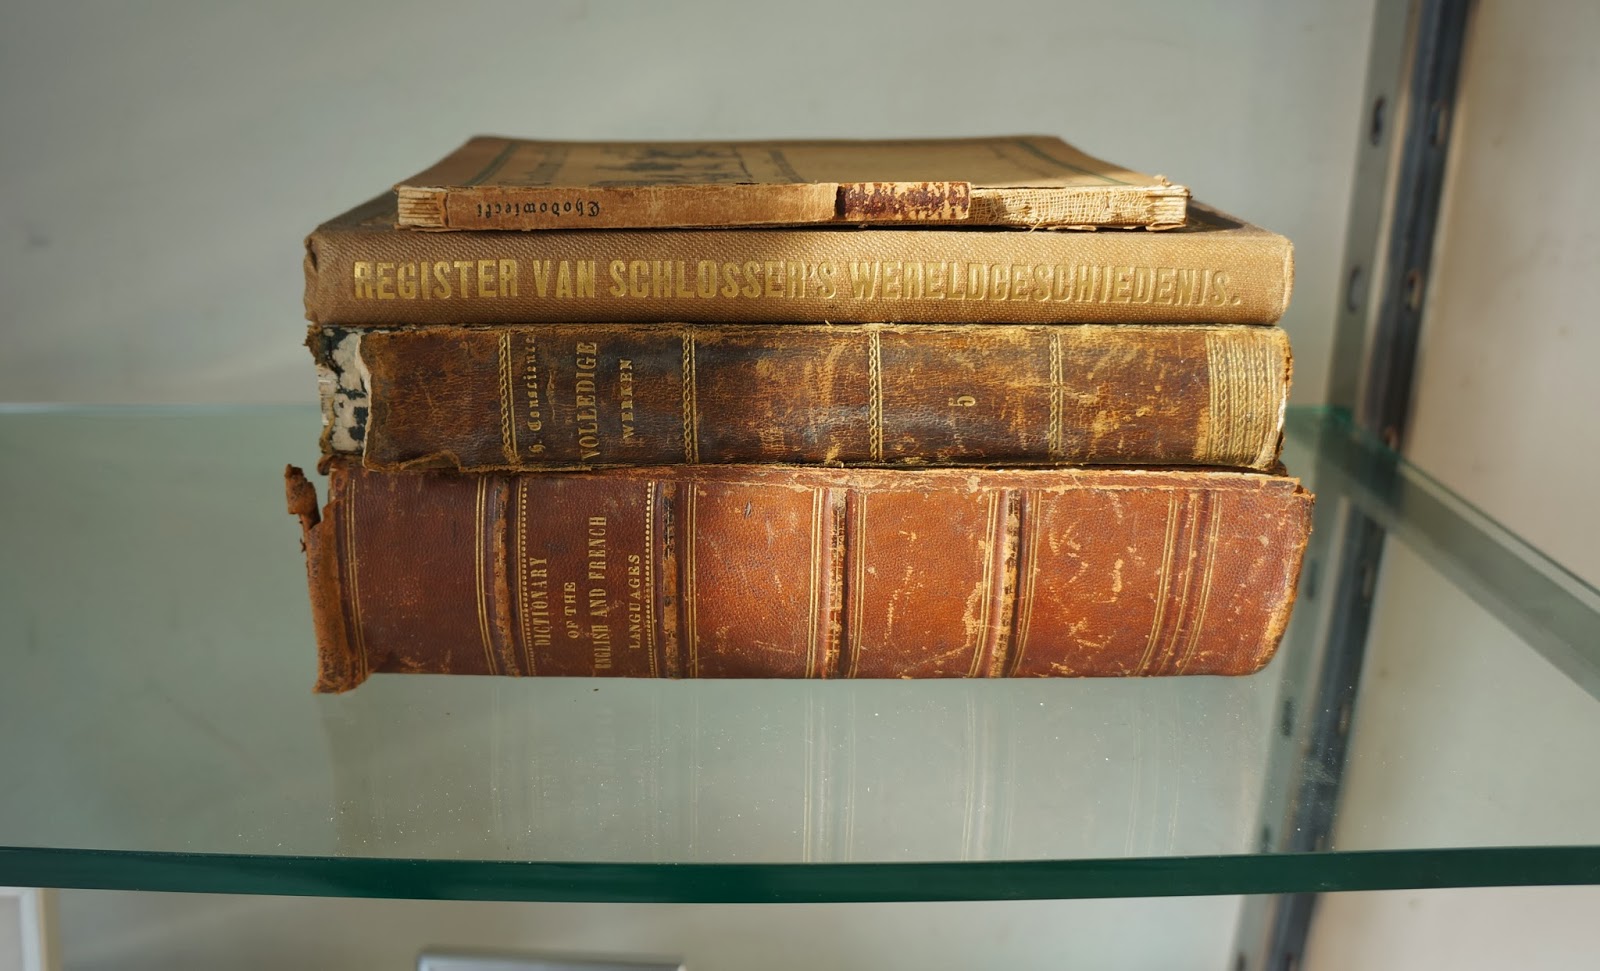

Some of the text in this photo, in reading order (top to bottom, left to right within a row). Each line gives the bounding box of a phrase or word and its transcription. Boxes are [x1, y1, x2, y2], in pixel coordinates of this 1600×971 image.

[477, 198, 600, 219] Chodowiecki
[353, 259, 1242, 308] REGISTER VAN SCHLOSSER'S WERELDGESCHIEDENIS.
[576, 342, 600, 460] VOLLEDIGE
[620, 359, 634, 439] WERKEN
[947, 395, 976, 407] 5
[530, 556, 551, 646] DICTIONARY
[564, 581, 579, 639] OF THE
[588, 516, 611, 669] ENGLISH AND FRENCH
[628, 554, 641, 649] LANGUAGES
